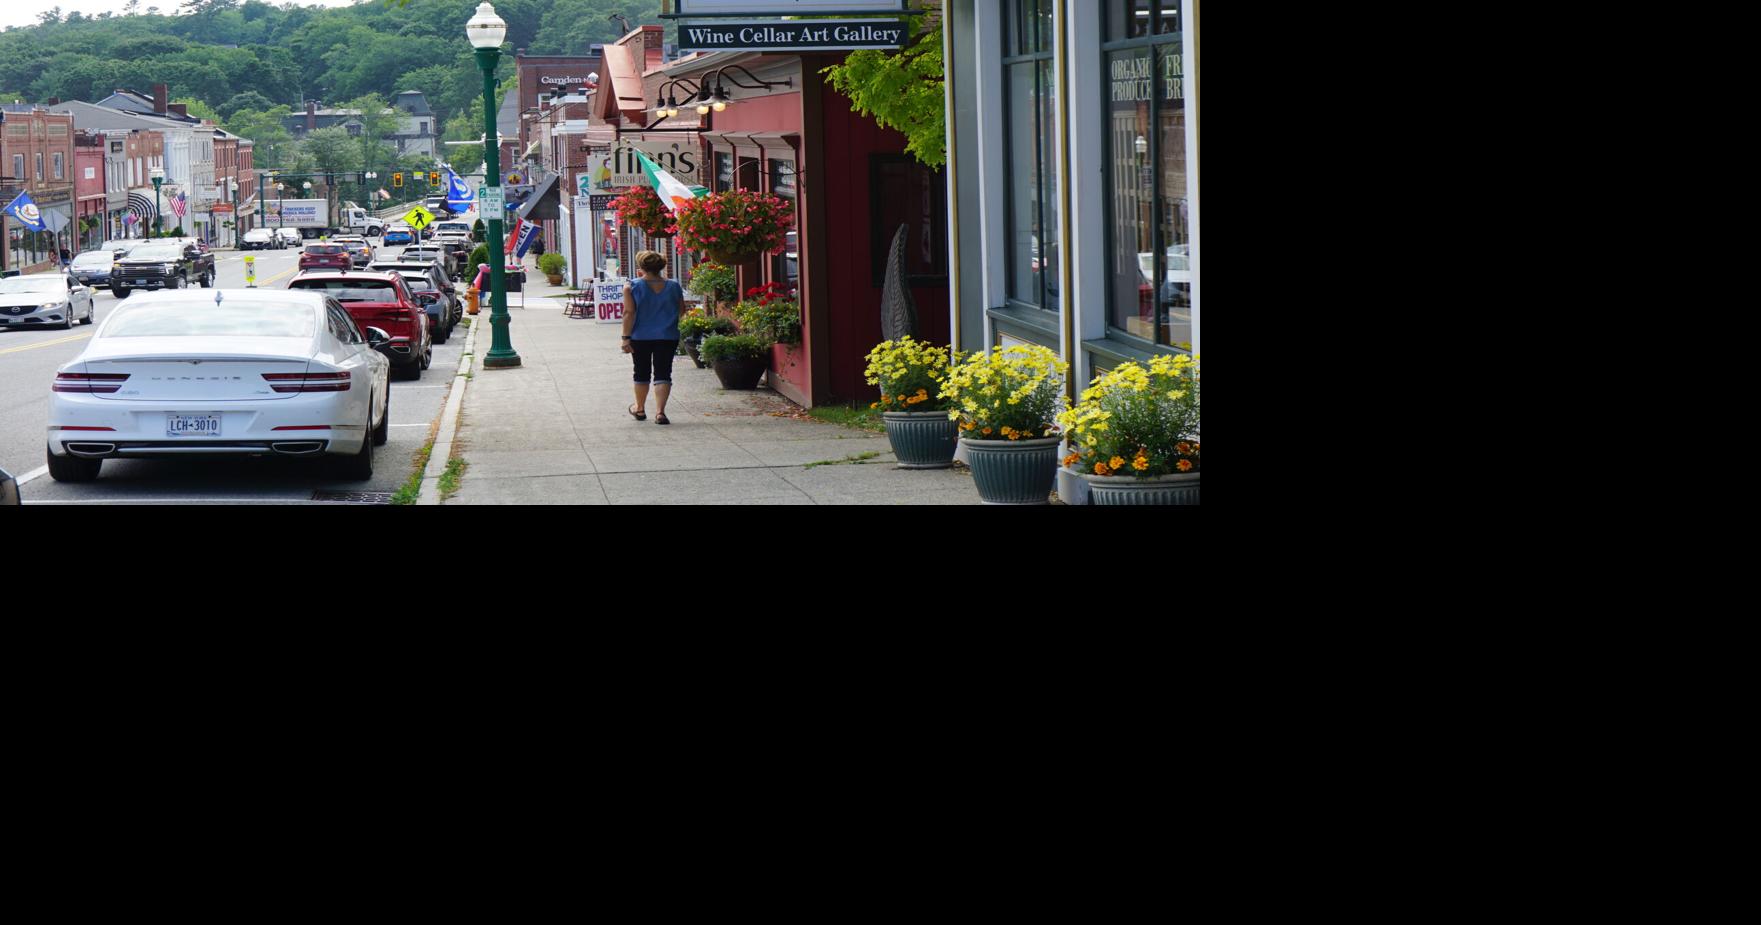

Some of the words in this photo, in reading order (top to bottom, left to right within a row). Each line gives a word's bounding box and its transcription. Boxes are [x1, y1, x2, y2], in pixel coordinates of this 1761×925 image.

[688, 28, 734, 44] Wine
[740, 27, 795, 43] Cellar
[800, 26, 830, 42] Art
[834, 25, 901, 44] Gallery
[541, 75, 582, 85] Camden
